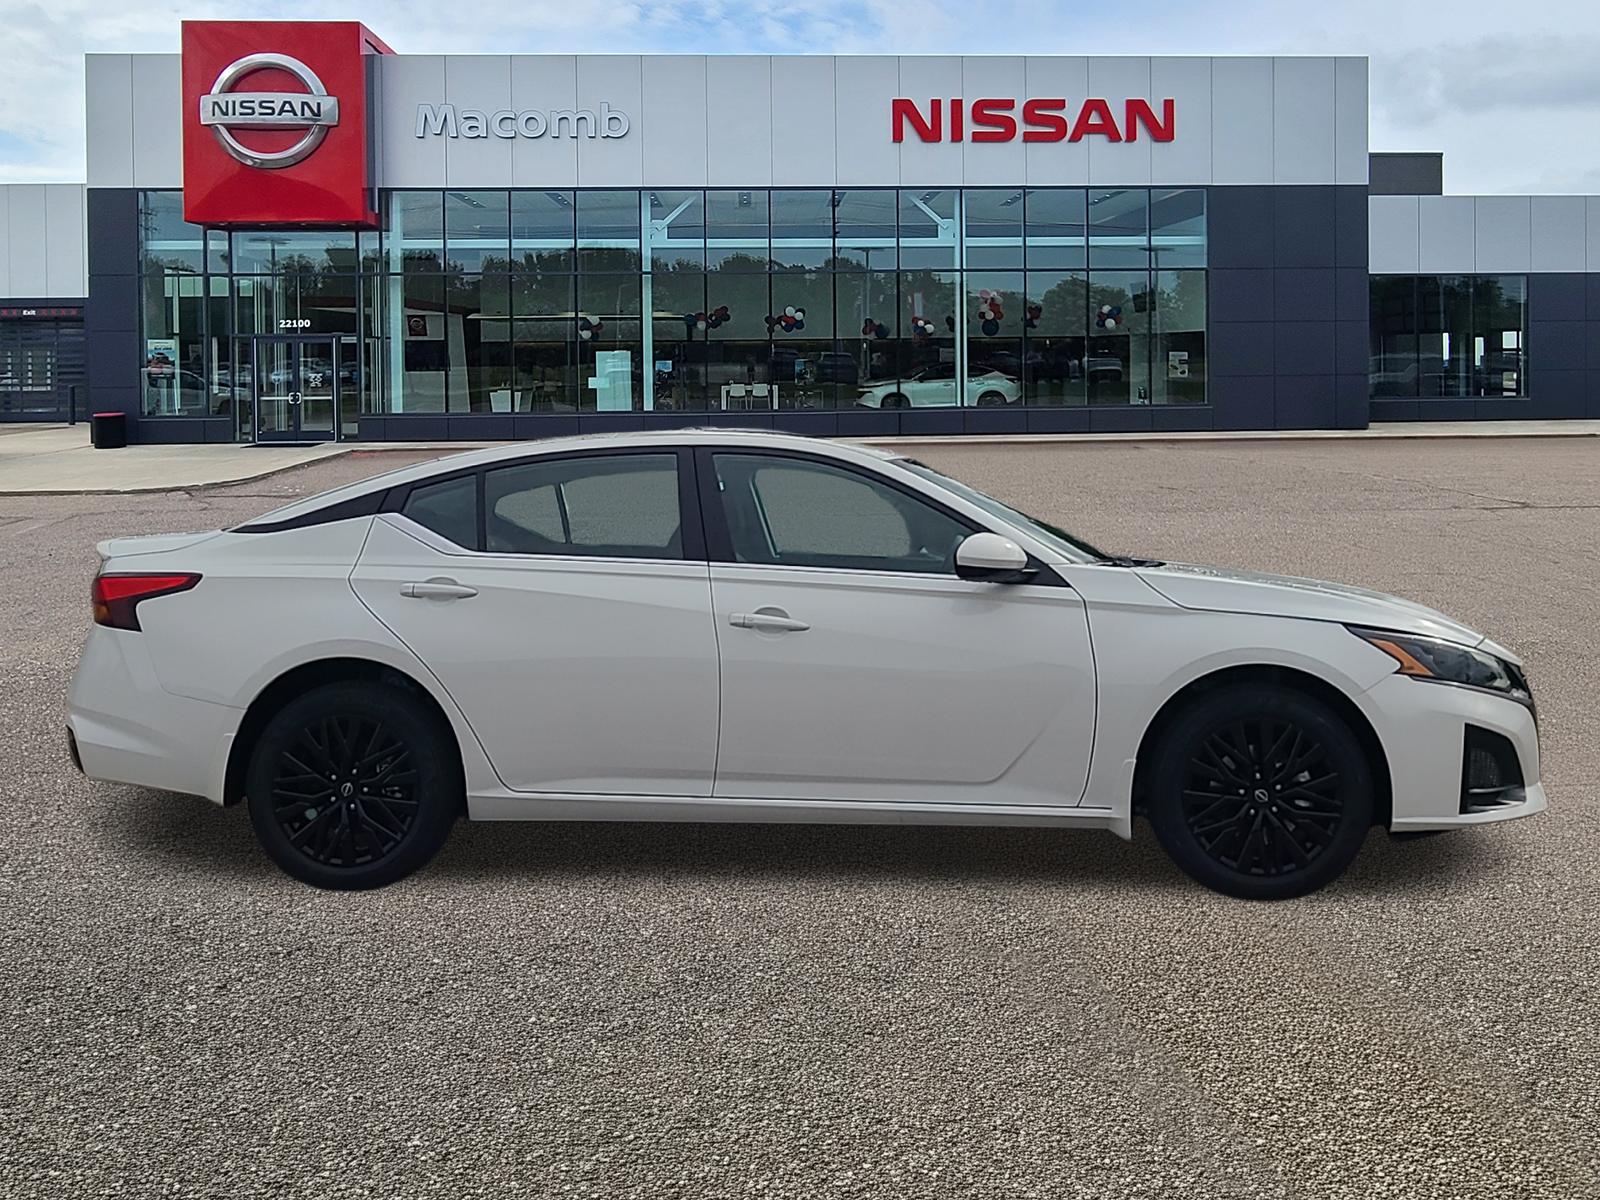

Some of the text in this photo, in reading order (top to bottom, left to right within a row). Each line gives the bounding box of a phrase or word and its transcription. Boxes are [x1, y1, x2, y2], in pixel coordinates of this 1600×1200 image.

[211, 100, 322, 117] NISSAN
[415, 102, 630, 139] Macomb
[892, 98, 1175, 143] NISSAN
[279, 319, 311, 328] 22100
